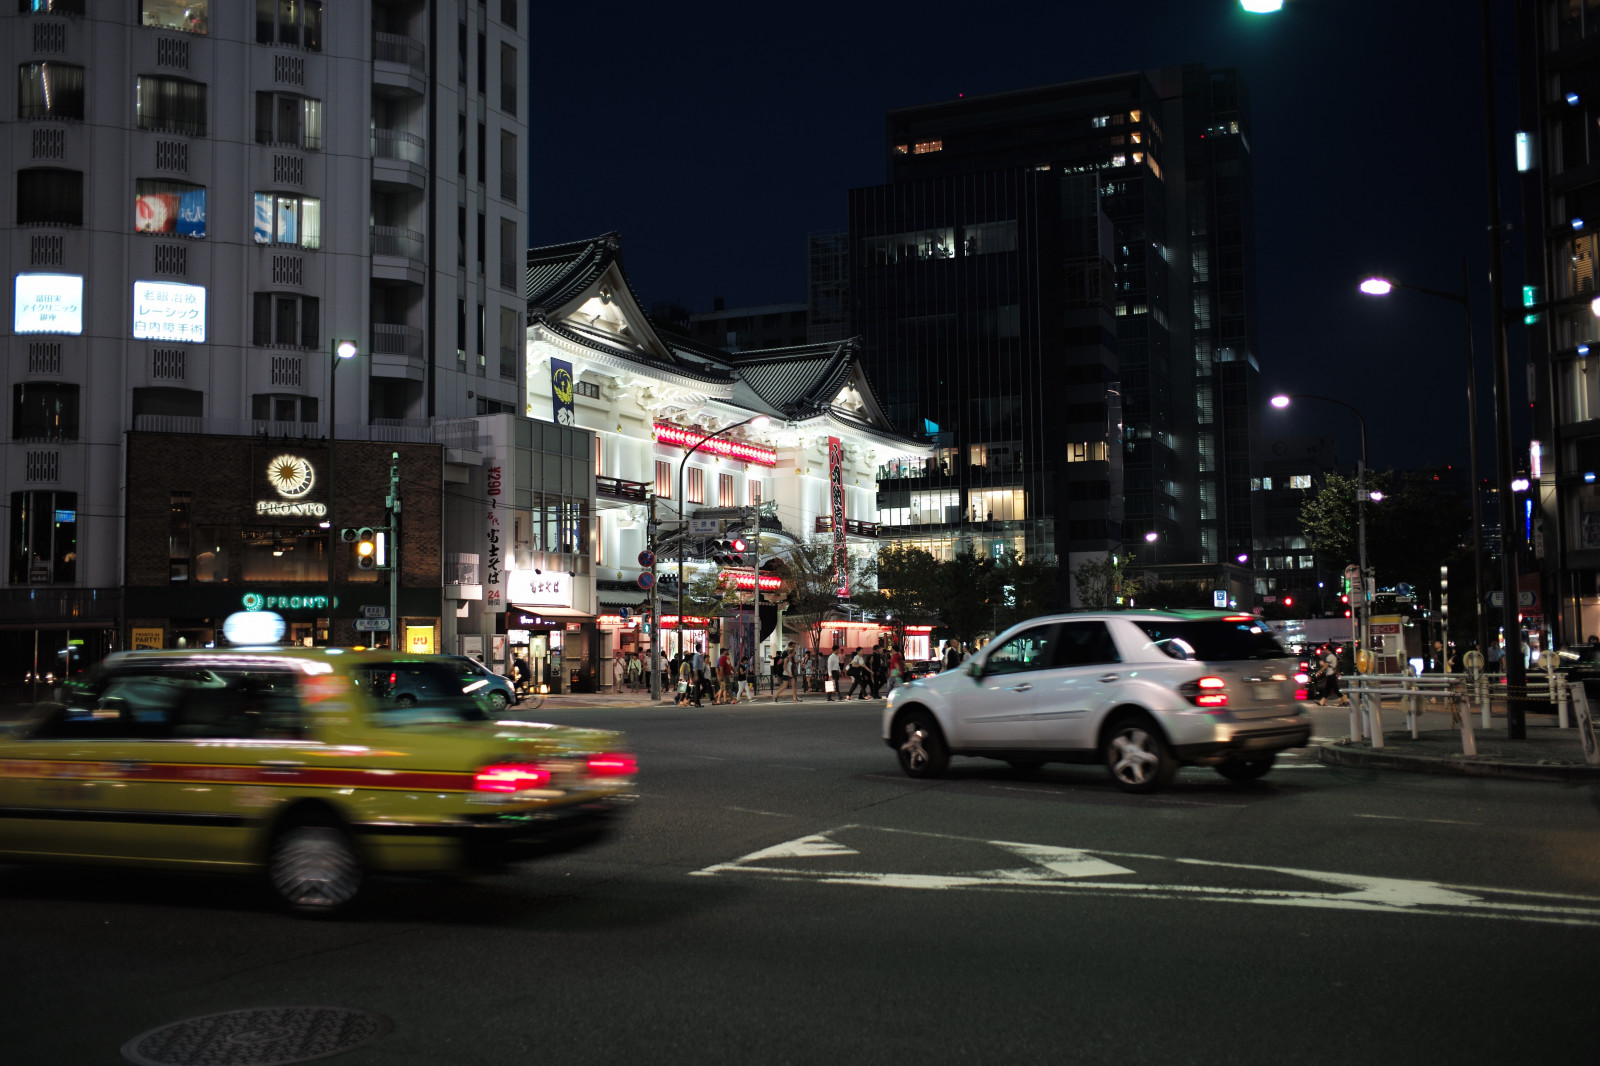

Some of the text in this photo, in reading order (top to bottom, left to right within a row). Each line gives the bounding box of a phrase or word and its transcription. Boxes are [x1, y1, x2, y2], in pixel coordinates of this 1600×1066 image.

[144, 290, 197, 304] 老眼治療
[23, 304, 78, 312] アイクリニック
[139, 304, 199, 319] レーシック
[40, 313, 57, 321] 銀座
[134, 320, 204, 335] 白内障手術
[256, 501, 327, 516] PRONTO
[486, 528, 502, 585] 富士そば
[530, 580, 561, 594] 富士そば
[488, 590, 501, 599] 24
[1371, 625, 1396, 634] 宝くじ
